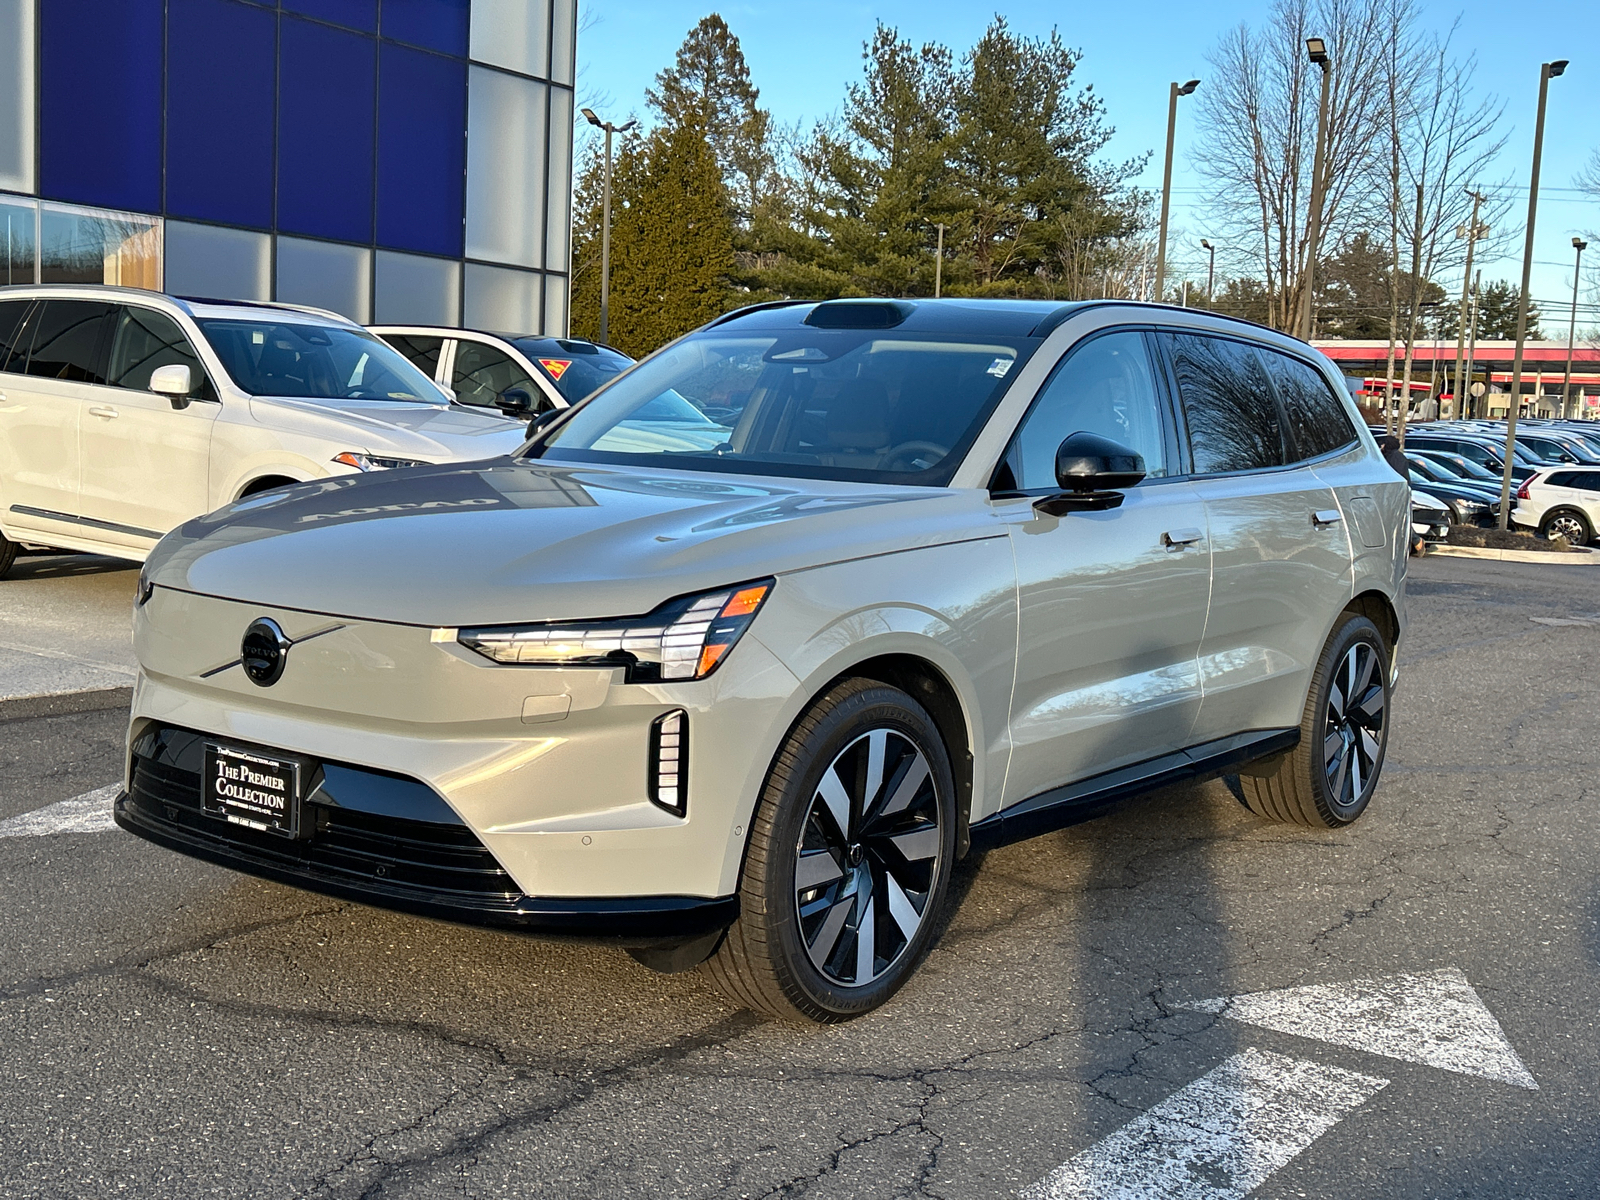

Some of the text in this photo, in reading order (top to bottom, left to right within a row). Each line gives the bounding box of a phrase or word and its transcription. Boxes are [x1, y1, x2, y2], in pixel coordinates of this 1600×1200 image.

[244, 645, 278, 658] VOLVO
[216, 760, 285, 791] THE PREMIER
[215, 777, 285, 810] COLLECTION
